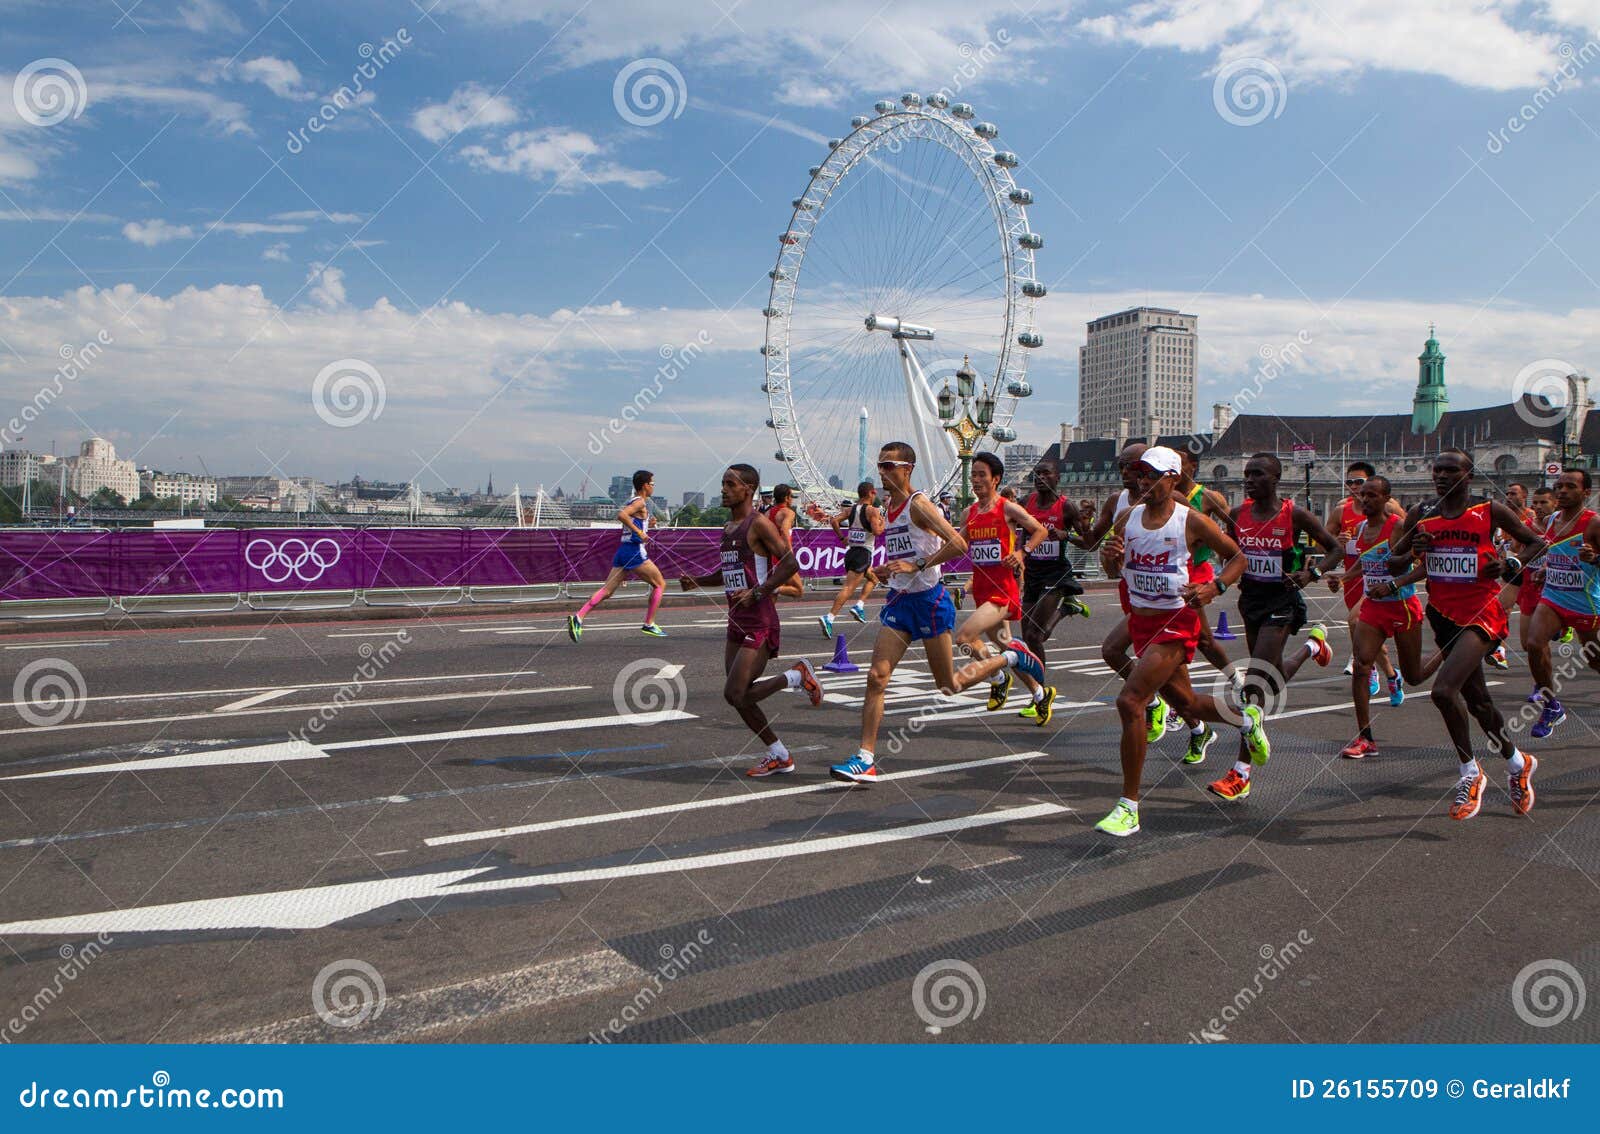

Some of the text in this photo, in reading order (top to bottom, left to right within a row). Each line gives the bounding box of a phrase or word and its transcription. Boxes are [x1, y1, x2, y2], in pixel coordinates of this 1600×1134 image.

[969, 527, 997, 539] CHINA
[1238, 536, 1282, 548] KENYA
[1130, 548, 1170, 567] USA
[1427, 555, 1476, 574] KIPROTICH
[1133, 573, 1169, 593] KEFLEZIGHI
